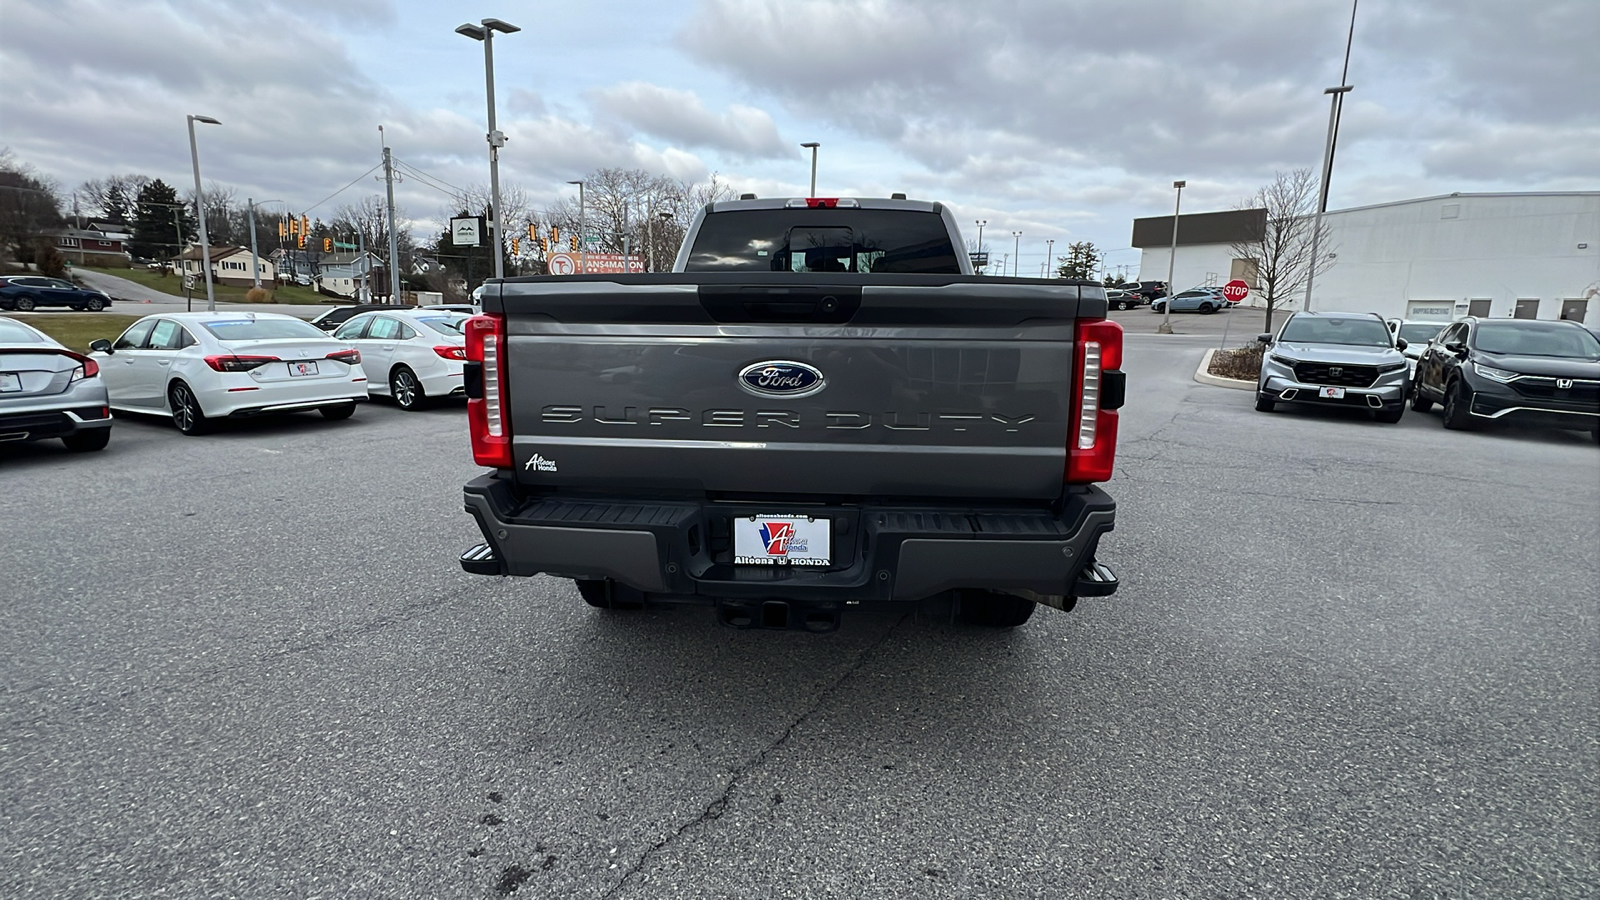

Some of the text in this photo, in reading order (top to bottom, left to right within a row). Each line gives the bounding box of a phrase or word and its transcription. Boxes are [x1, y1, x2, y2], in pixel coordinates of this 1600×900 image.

[576, 260, 643, 269] TANS4MATON
[1224, 286, 1248, 296] STOP
[758, 367, 803, 387] Ford
[541, 404, 1036, 433] SUPER DUTY
[734, 557, 774, 565] Altoona
